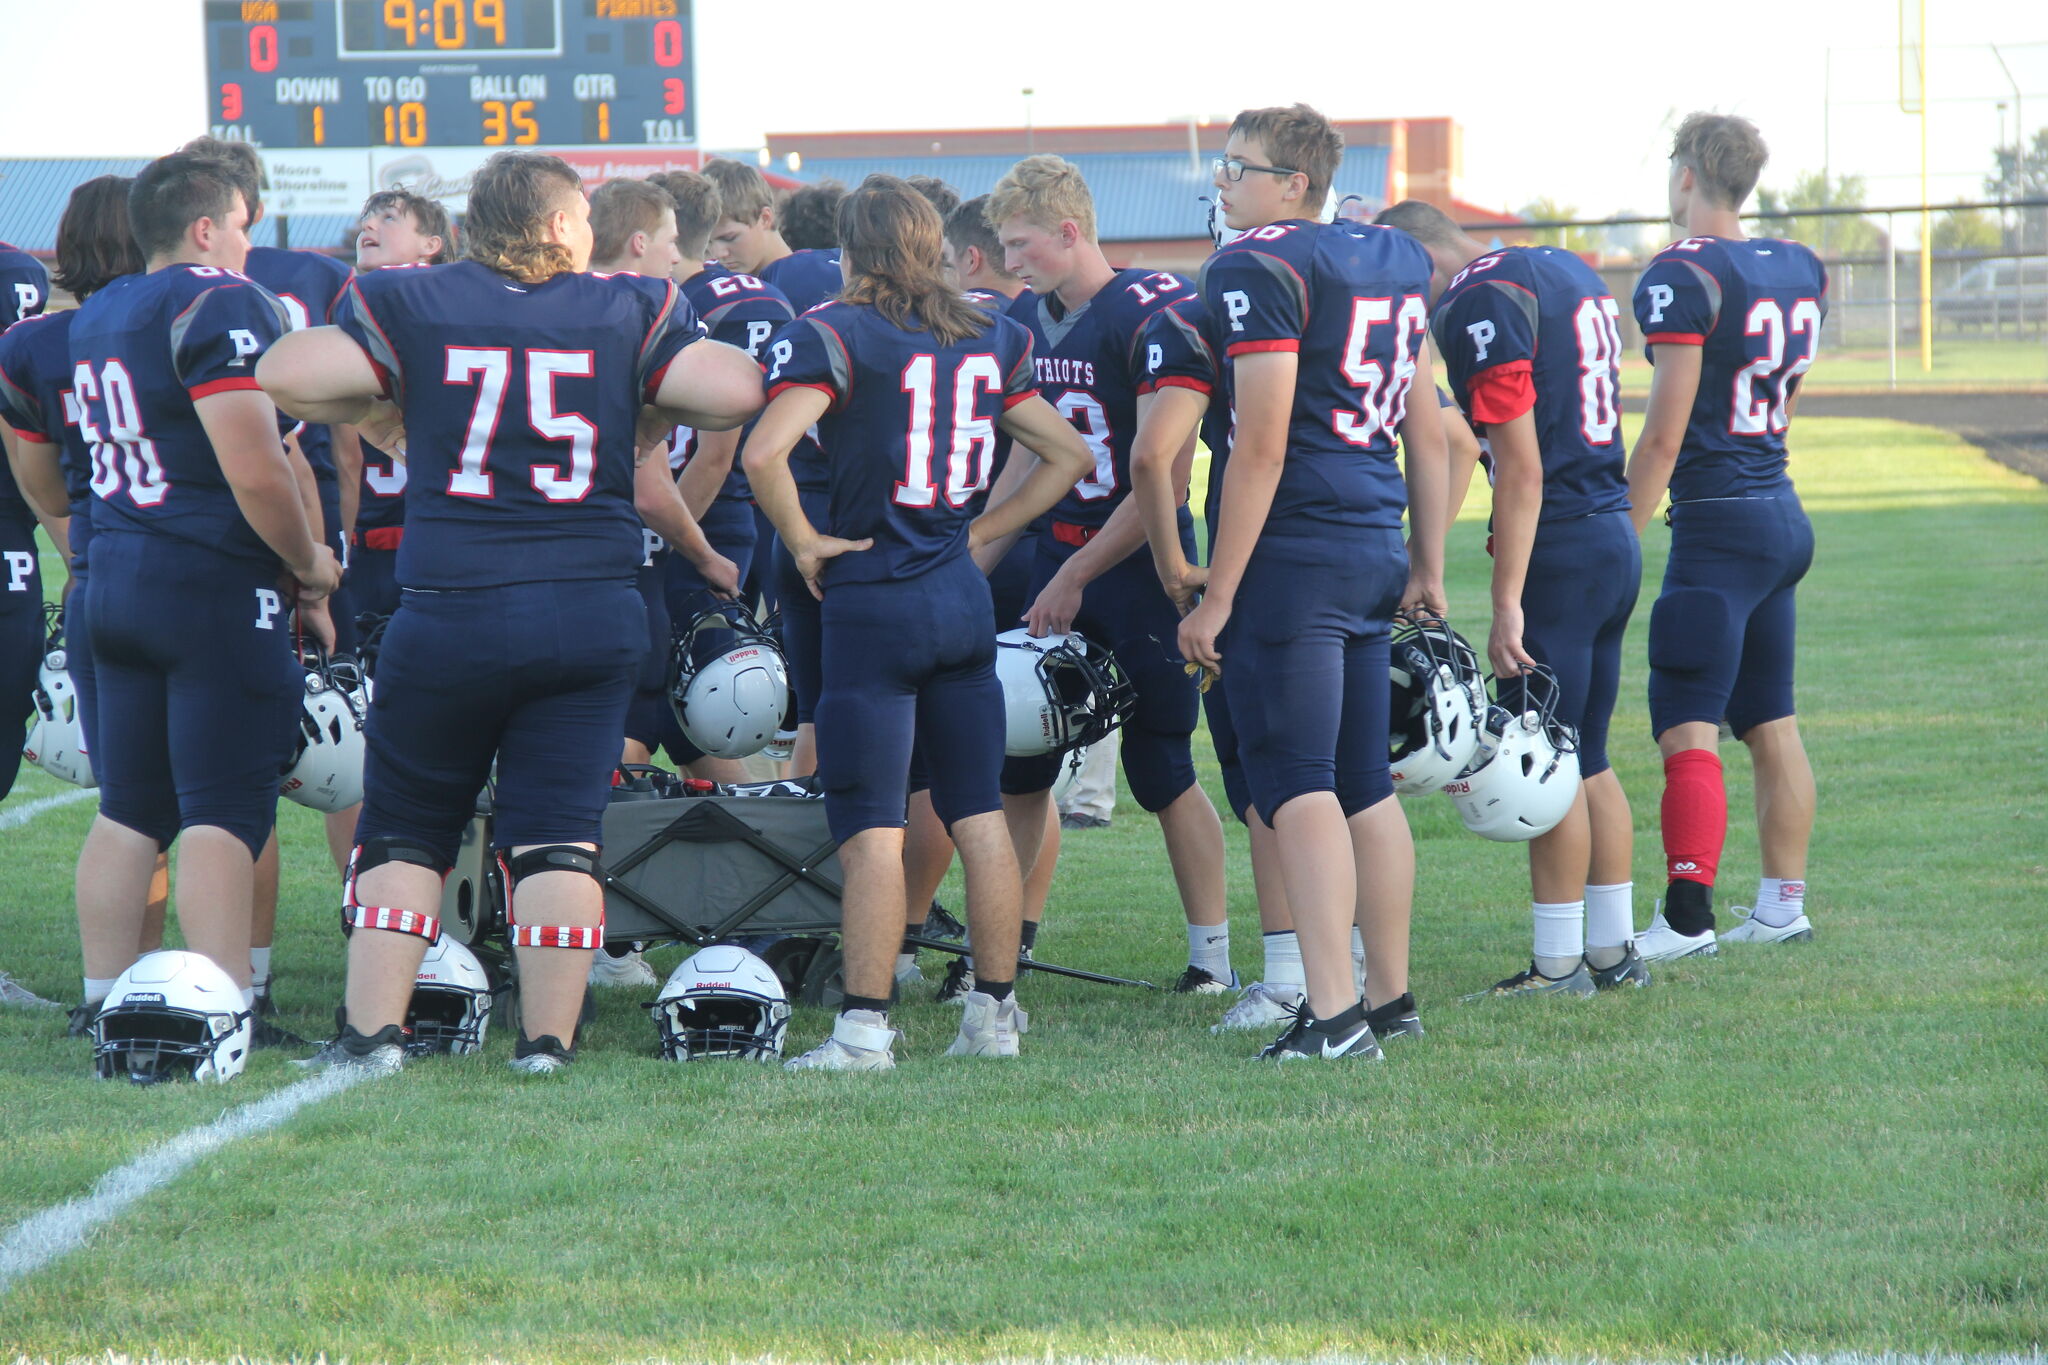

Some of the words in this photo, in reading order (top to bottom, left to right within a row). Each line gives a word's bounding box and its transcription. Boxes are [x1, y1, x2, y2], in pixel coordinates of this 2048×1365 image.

[384, 0, 506, 48] 9:09
[654, 20, 683, 67] 0
[249, 25, 278, 72] 0
[221, 83, 243, 120] 3
[276, 77, 340, 104] DOWN
[364, 76, 393, 102] TO
[396, 76, 426, 101] GO
[470, 75, 517, 100] BALL
[518, 74, 546, 100] ON
[574, 73, 616, 100] QTR
[663, 77, 685, 115] 3
[313, 105, 324, 145] 1
[384, 102, 426, 146] 10
[482, 101, 539, 145] 35
[598, 102, 609, 141] 1
[14, 283, 39, 320] P
[1125, 272, 1182, 306] 13
[1648, 284, 1674, 323] P
[1222, 290, 1251, 332] P
[227, 329, 258, 366] P
[745, 320, 772, 357] P
[1467, 319, 1497, 362] P
[769, 338, 793, 380] P
[1332, 294, 1427, 447] 56
[1728, 298, 1822, 436] 22
[443, 344, 598, 502] 75
[892, 352, 1004, 508] 16
[642, 527, 664, 567] P
[3, 551, 34, 592] P
[255, 587, 281, 630] P
[729, 648, 760, 663] Riddell
[1040, 713, 1051, 737] Riddell
[125, 993, 162, 1002] Riddell
[696, 980, 732, 989] Riddell
